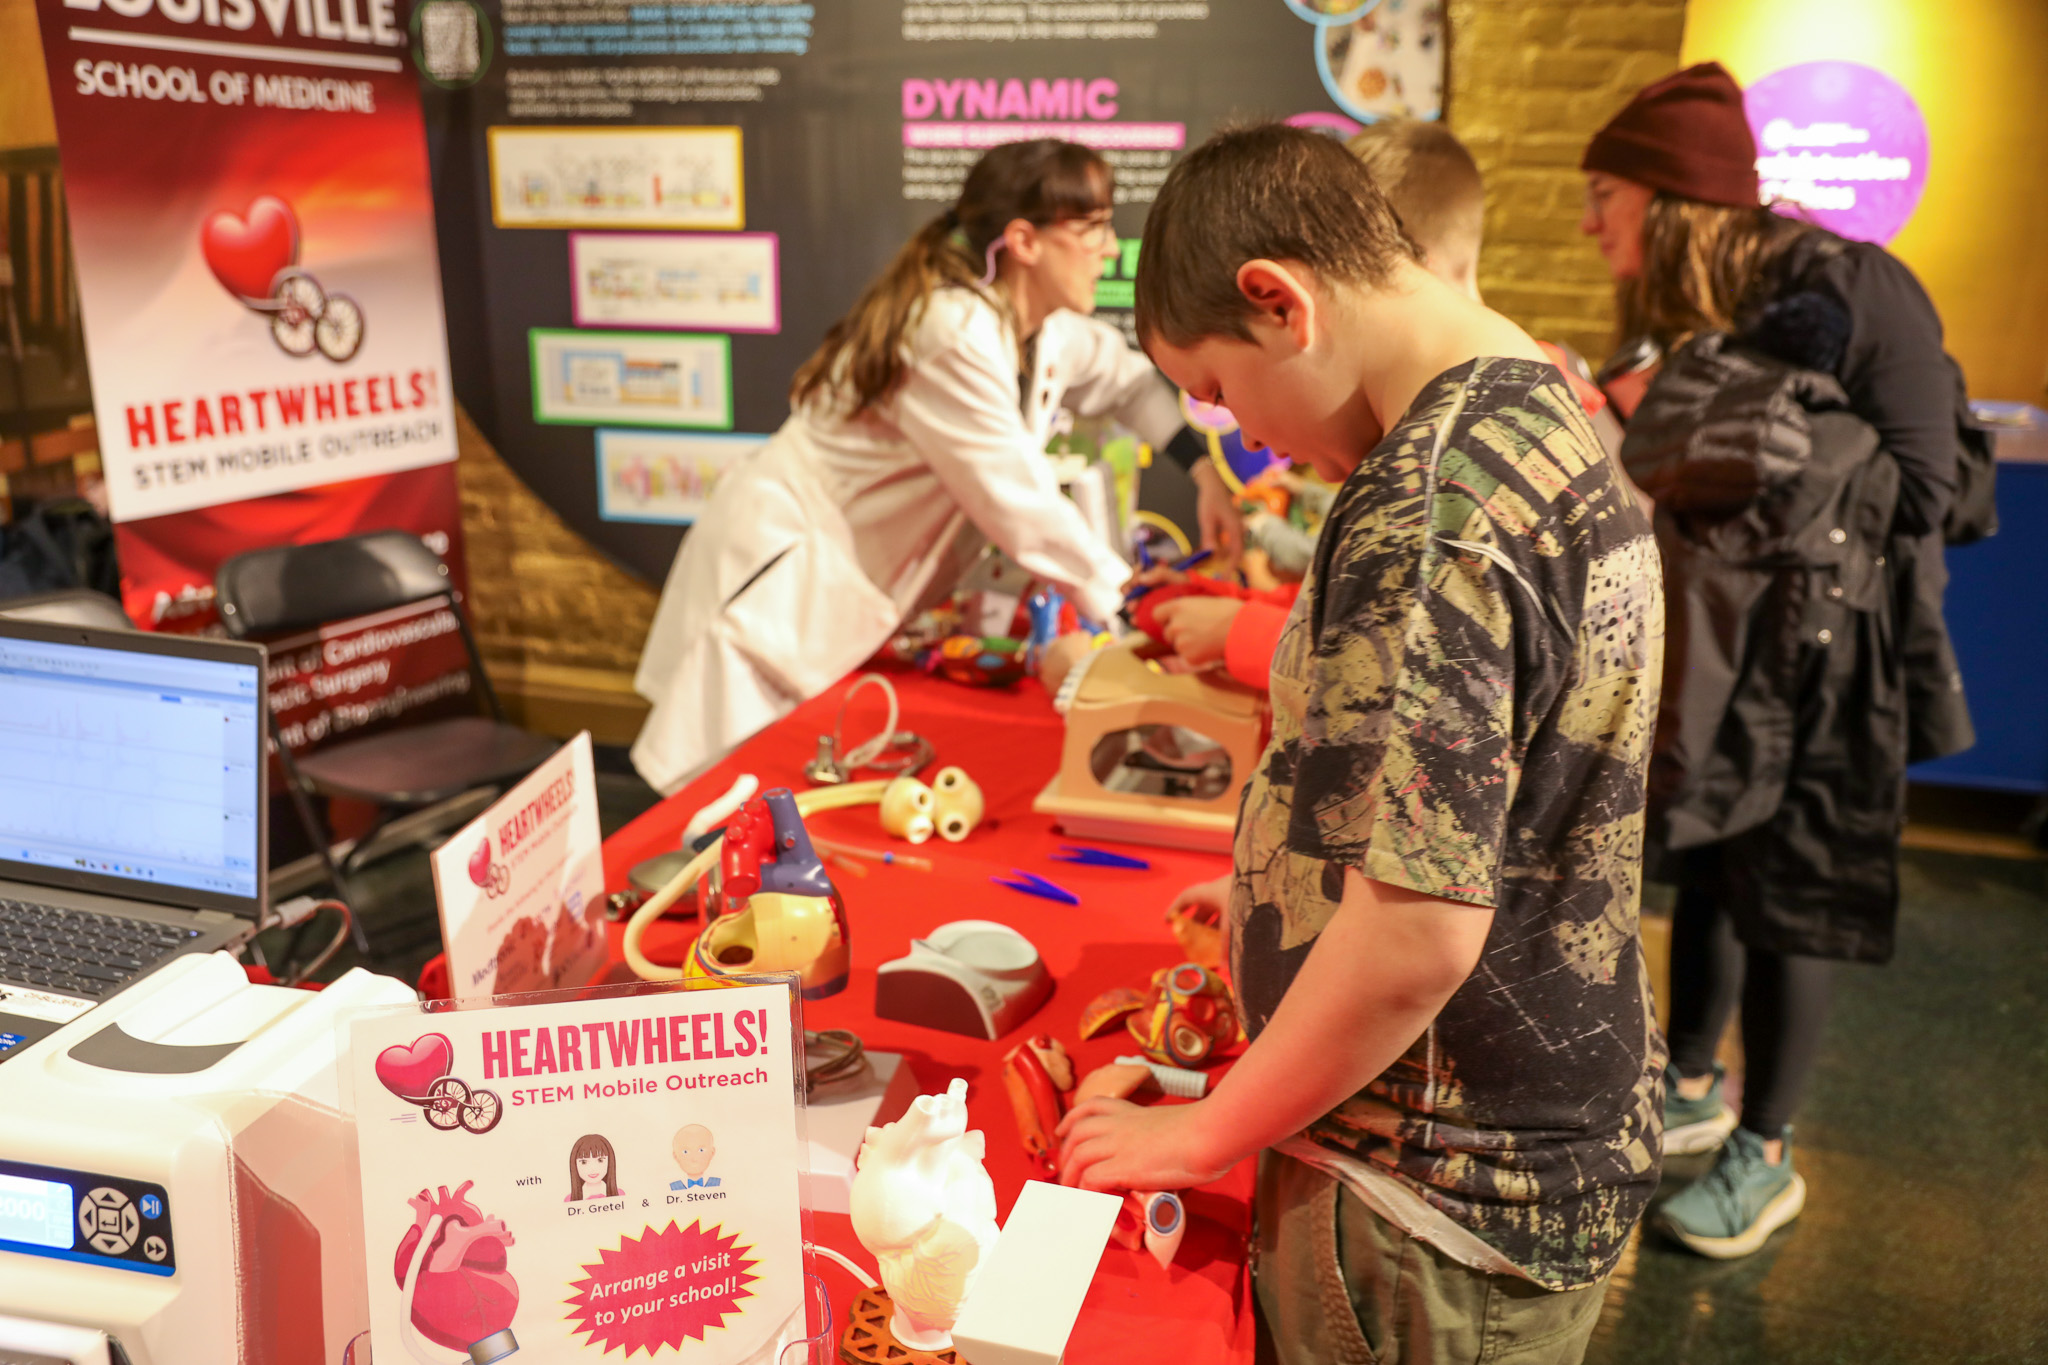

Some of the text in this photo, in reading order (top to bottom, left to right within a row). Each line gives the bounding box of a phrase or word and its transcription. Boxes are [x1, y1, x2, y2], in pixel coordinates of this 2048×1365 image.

[74, 58, 376, 113] SCHOOL OF MEDICINE
[902, 78, 1119, 120] DYNAMIC
[124, 369, 438, 448] HEARTWHEELS!
[134, 417, 443, 490] STEM MOBILE OUTREACH
[310, 658, 390, 699] Surgery
[482, 1009, 768, 1080] HEARTWHEELS!
[512, 1067, 768, 1106] STEM Mobile Outreach
[516, 1176, 542, 1187] with
[567, 1190, 727, 1216] Dr. Gretel & Dr. Steven
[590, 1252, 731, 1301] Arrange a visit
[594, 1275, 737, 1326] to your school!
